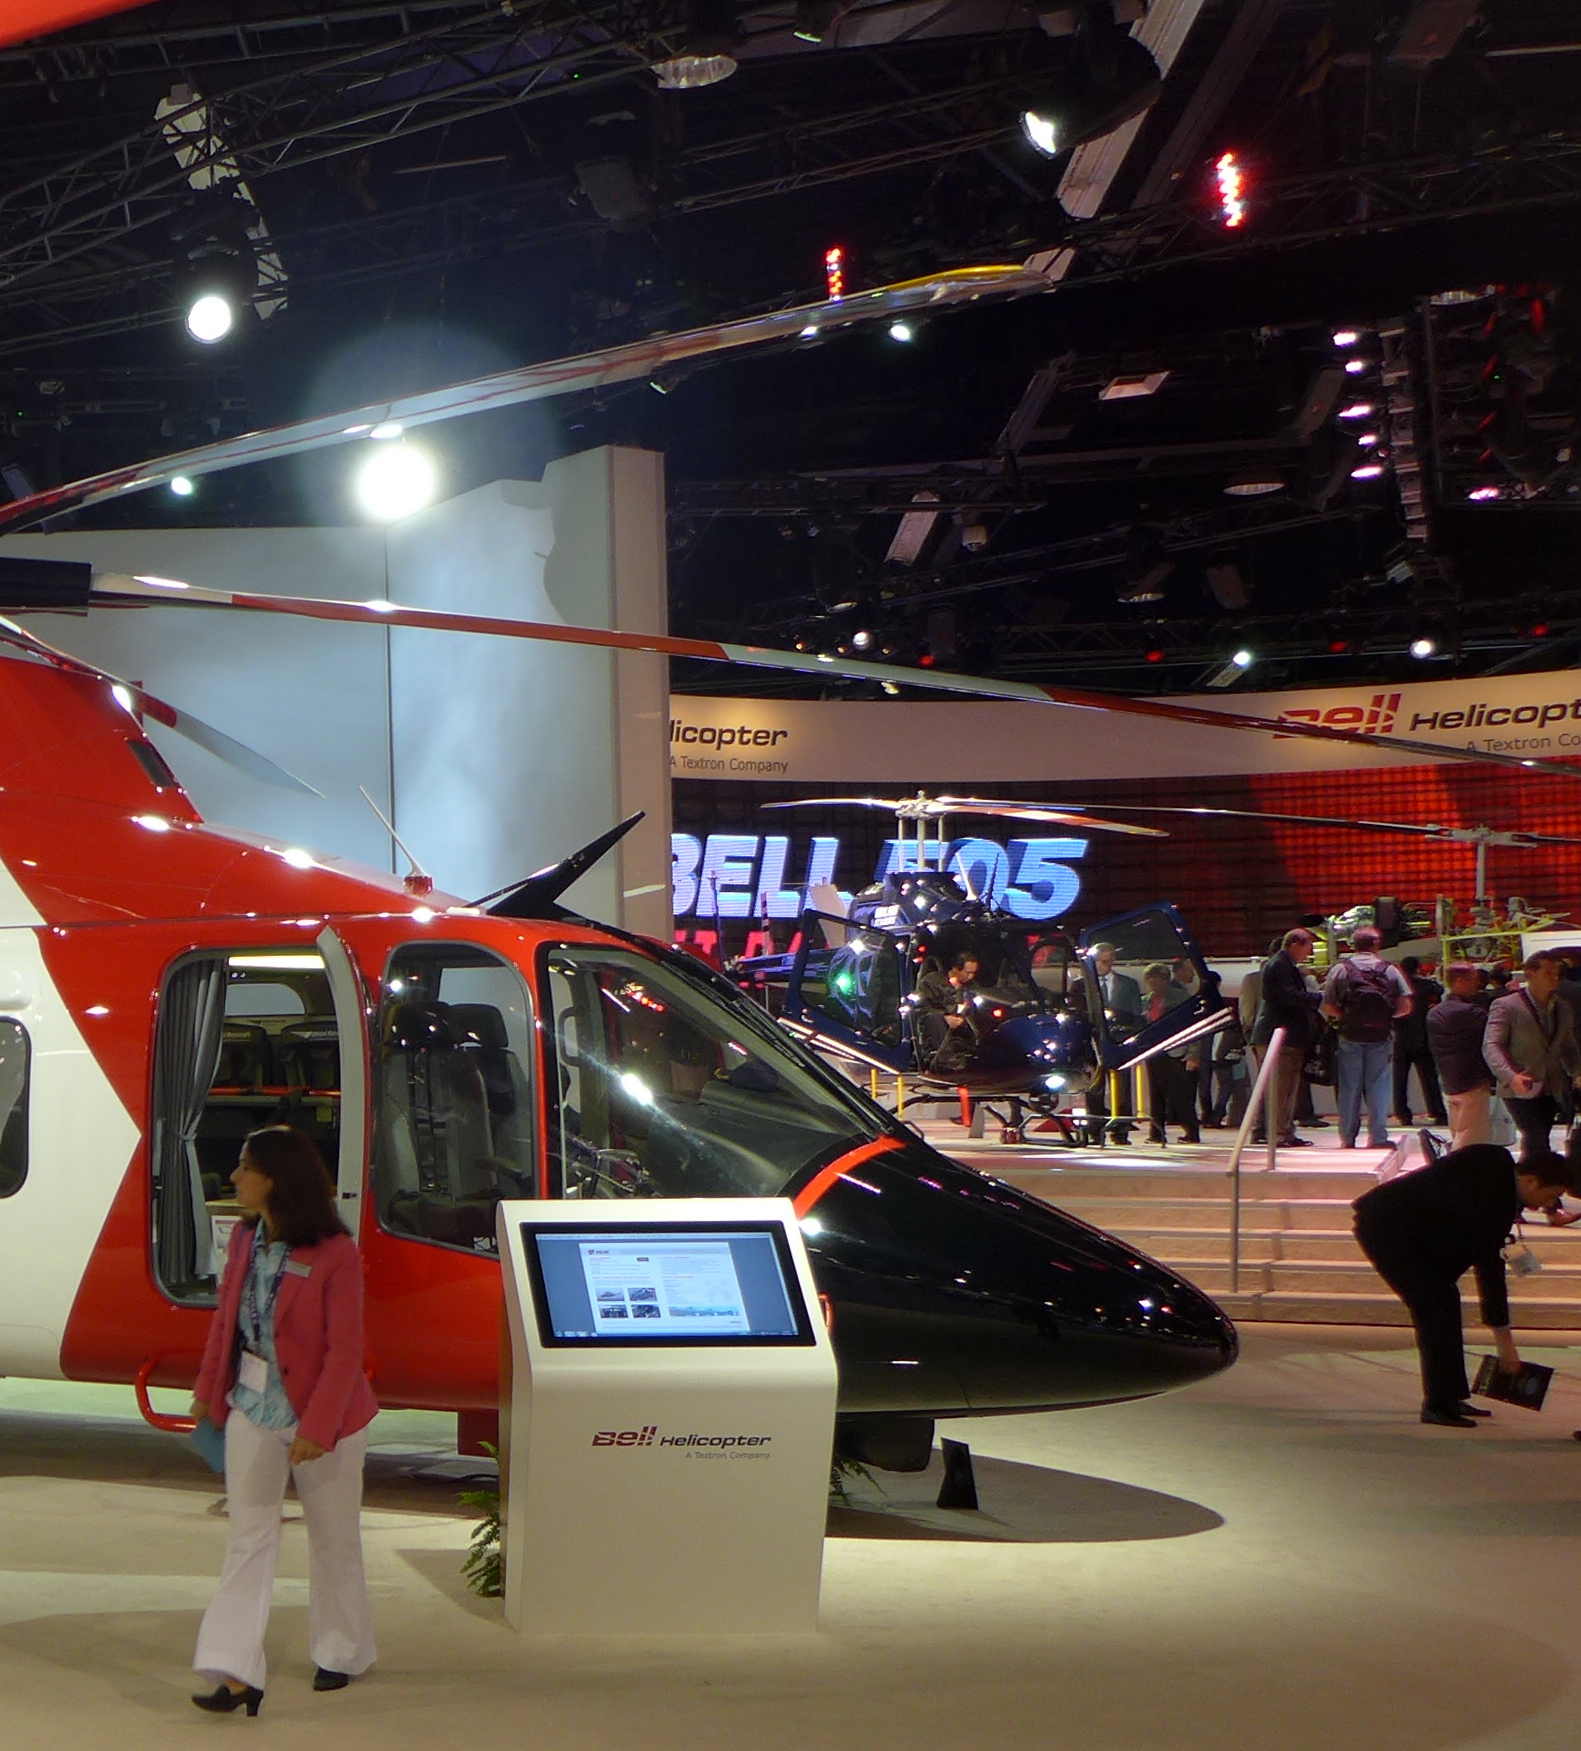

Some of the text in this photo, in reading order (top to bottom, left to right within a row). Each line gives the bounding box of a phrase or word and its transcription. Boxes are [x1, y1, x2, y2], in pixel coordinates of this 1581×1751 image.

[1483, 736, 1551, 753] Textron
[680, 755, 725, 770] Textron
[729, 758, 789, 774] Company
[671, 832, 855, 919] BELL
[591, 1425, 772, 1449] Bell Helicopter
[729, 1452, 770, 1460] Company
